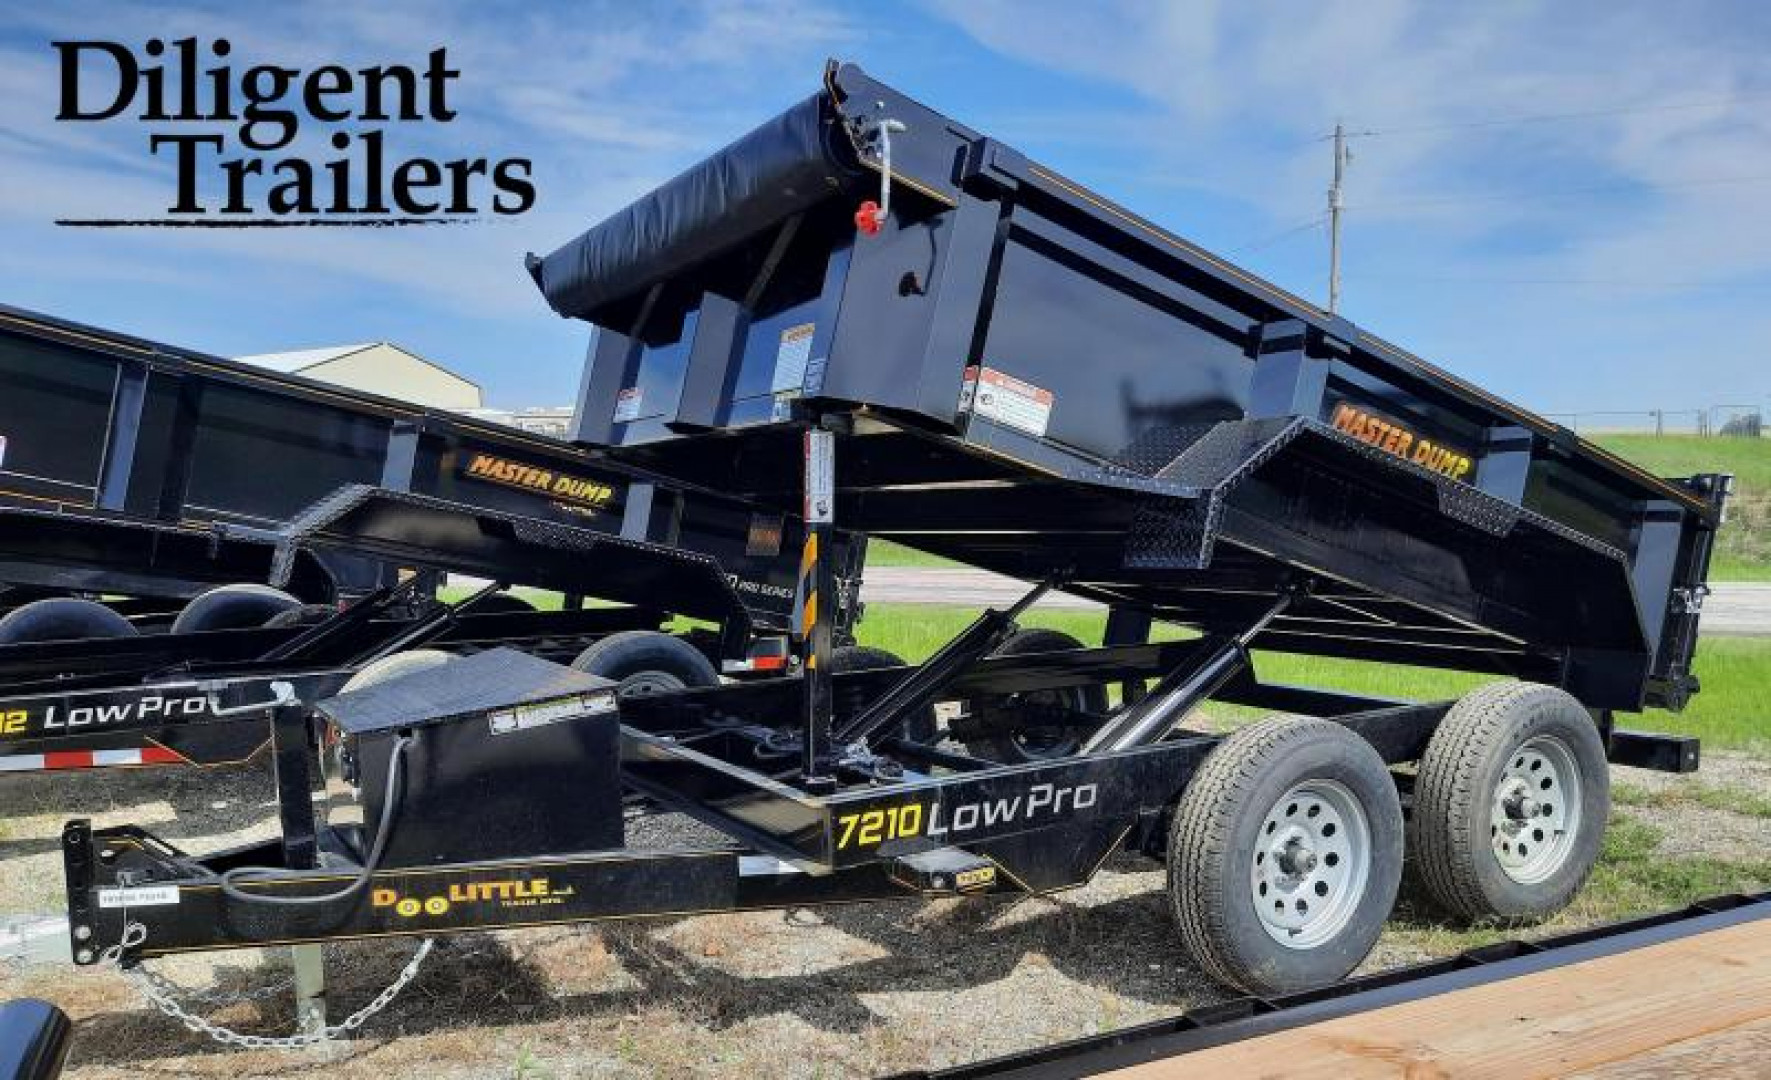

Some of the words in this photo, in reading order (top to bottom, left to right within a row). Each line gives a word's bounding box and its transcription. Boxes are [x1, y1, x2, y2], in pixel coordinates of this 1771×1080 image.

[1334, 404, 1413, 459] MASTER
[1412, 440, 1470, 480] DUMP
[469, 455, 552, 489] MASTER
[553, 477, 612, 503] DUMP
[837, 803, 922, 850] 7210
